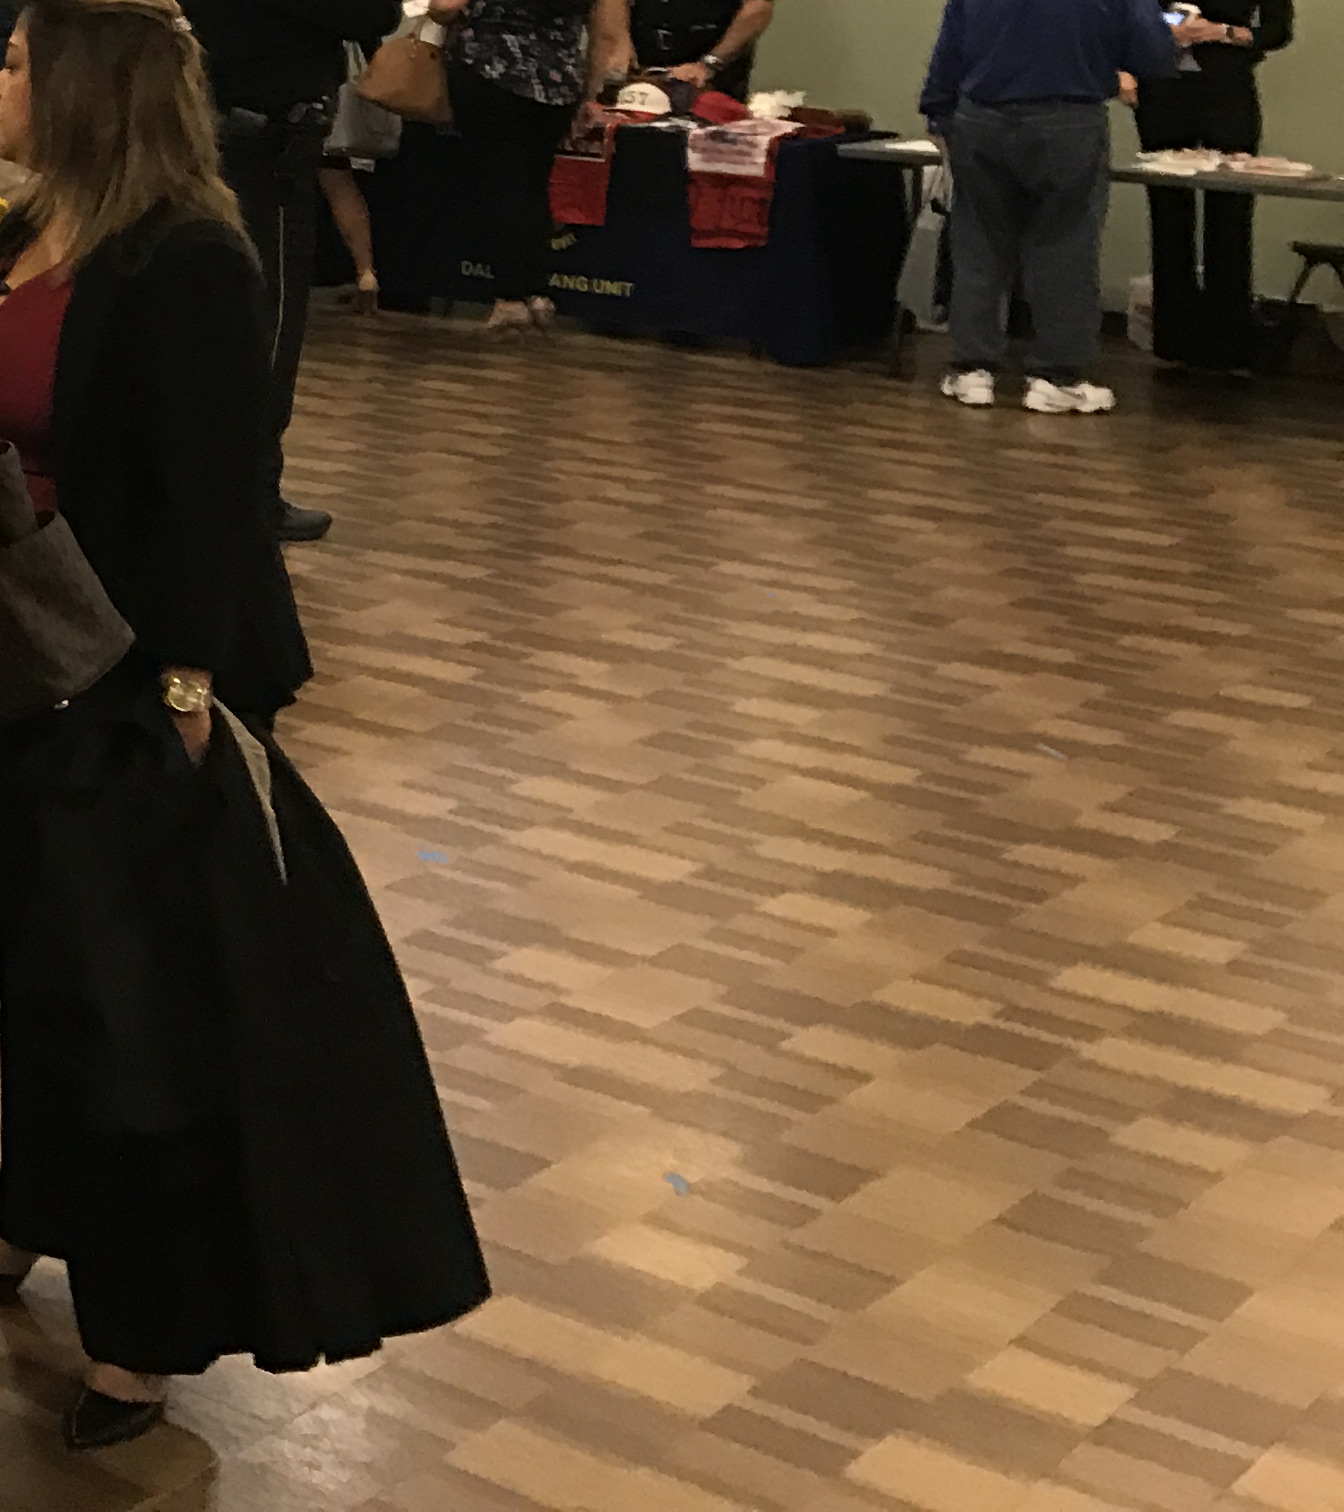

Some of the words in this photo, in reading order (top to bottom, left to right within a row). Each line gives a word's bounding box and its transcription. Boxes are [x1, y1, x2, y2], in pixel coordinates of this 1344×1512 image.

[460, 260, 495, 279] DAL
[548, 272, 589, 293] ANG
[592, 278, 634, 298] UNIT
